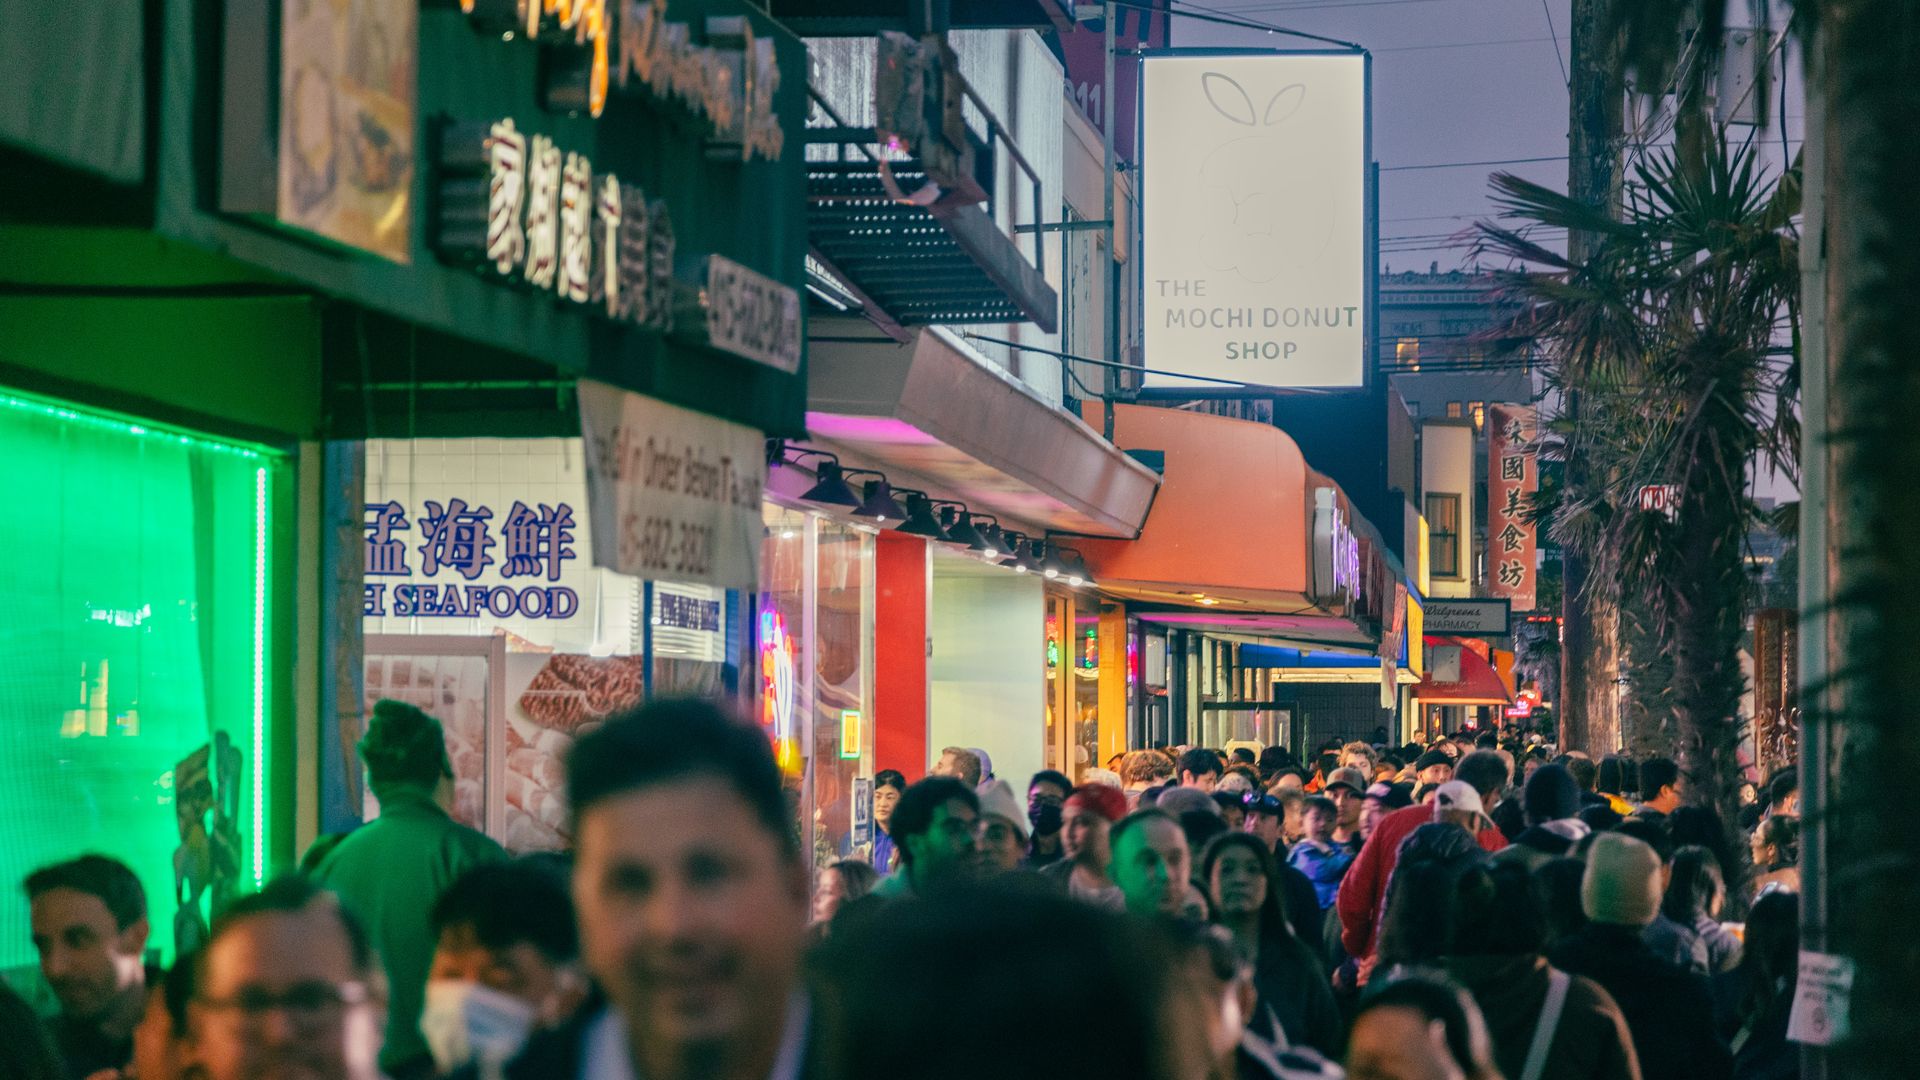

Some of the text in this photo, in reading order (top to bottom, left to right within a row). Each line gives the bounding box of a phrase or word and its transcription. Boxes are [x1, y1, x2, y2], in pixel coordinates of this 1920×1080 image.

[1156, 280, 1206, 297] THE
[1165, 306, 1358, 329] MOCHI DONUT
[1225, 341, 1297, 360] SHOP
[394, 584, 579, 620] SEAFOOD
[1424, 604, 1482, 619] Walgreens
[1423, 620, 1481, 630] PHARMACY
